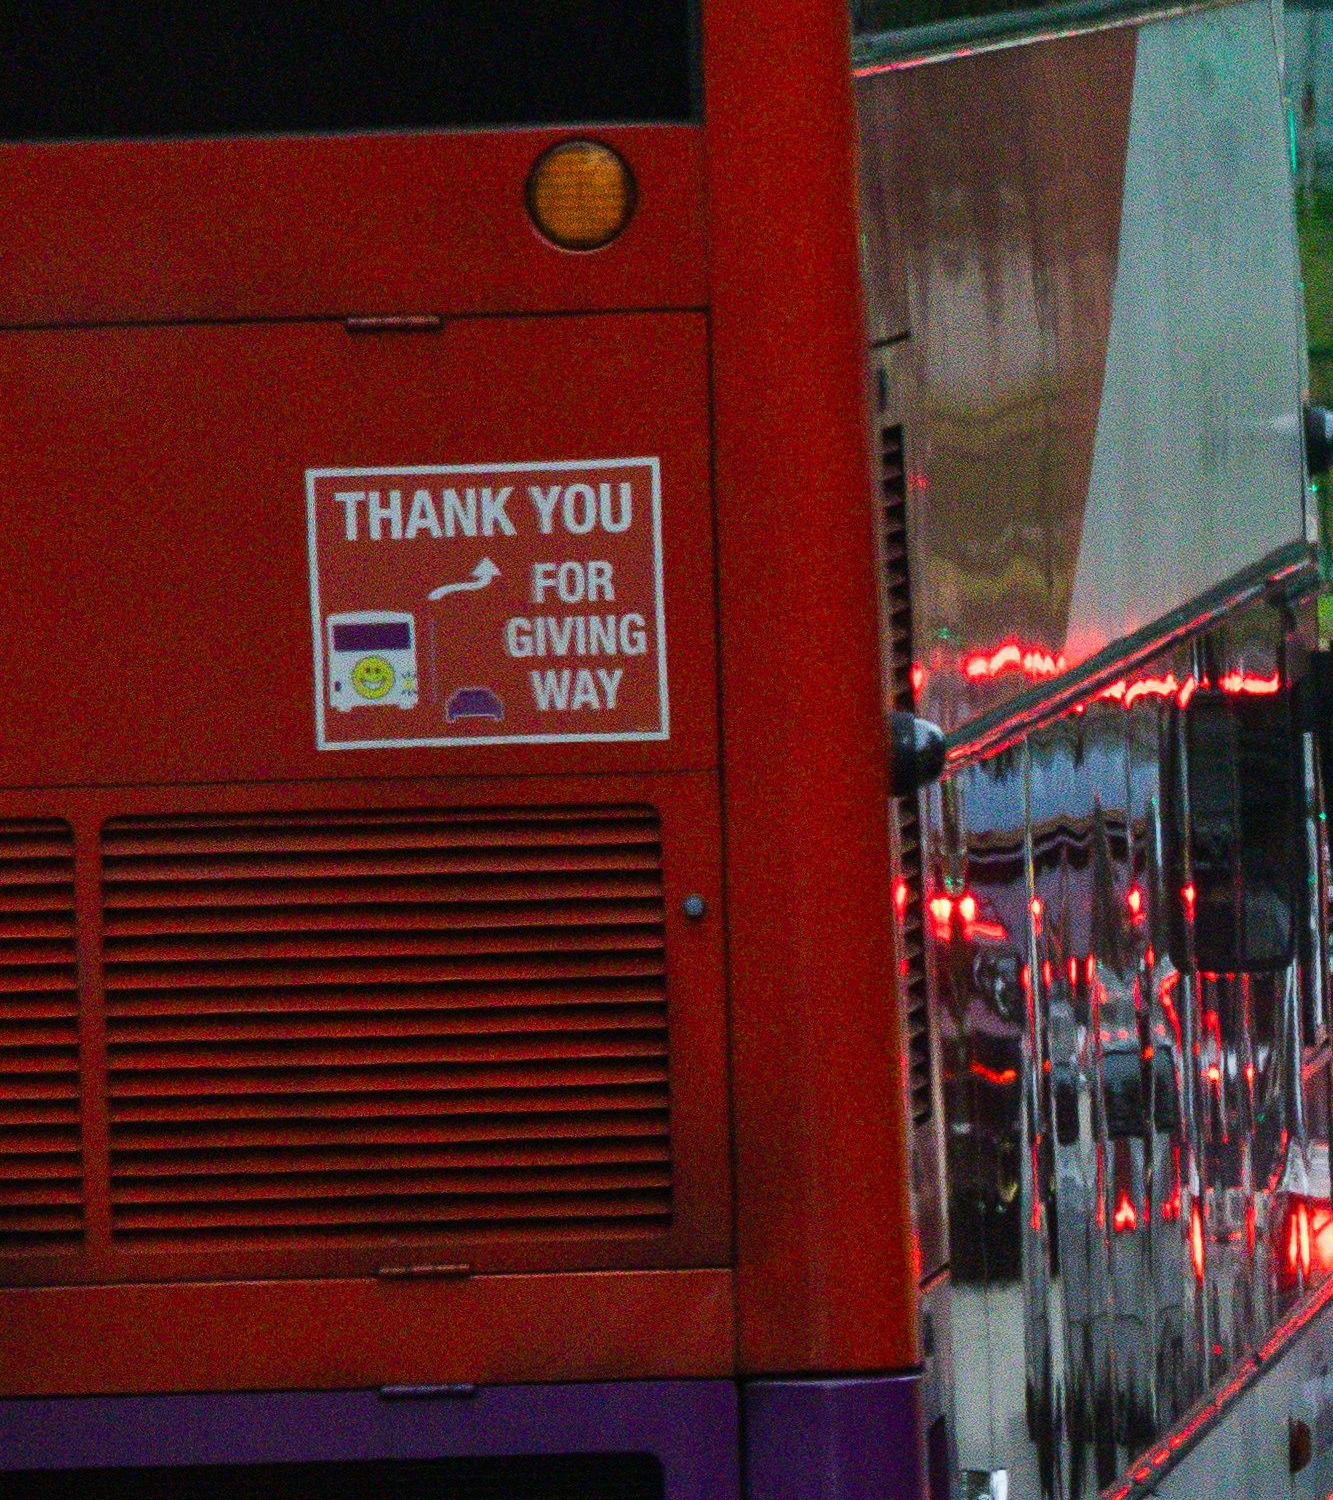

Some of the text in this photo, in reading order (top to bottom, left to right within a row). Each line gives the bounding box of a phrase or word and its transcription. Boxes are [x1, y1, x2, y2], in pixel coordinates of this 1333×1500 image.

[334, 482, 633, 541] THANK YOU
[532, 561, 615, 604] FOR
[506, 612, 647, 658] GIVING
[530, 668, 624, 711] WAY
